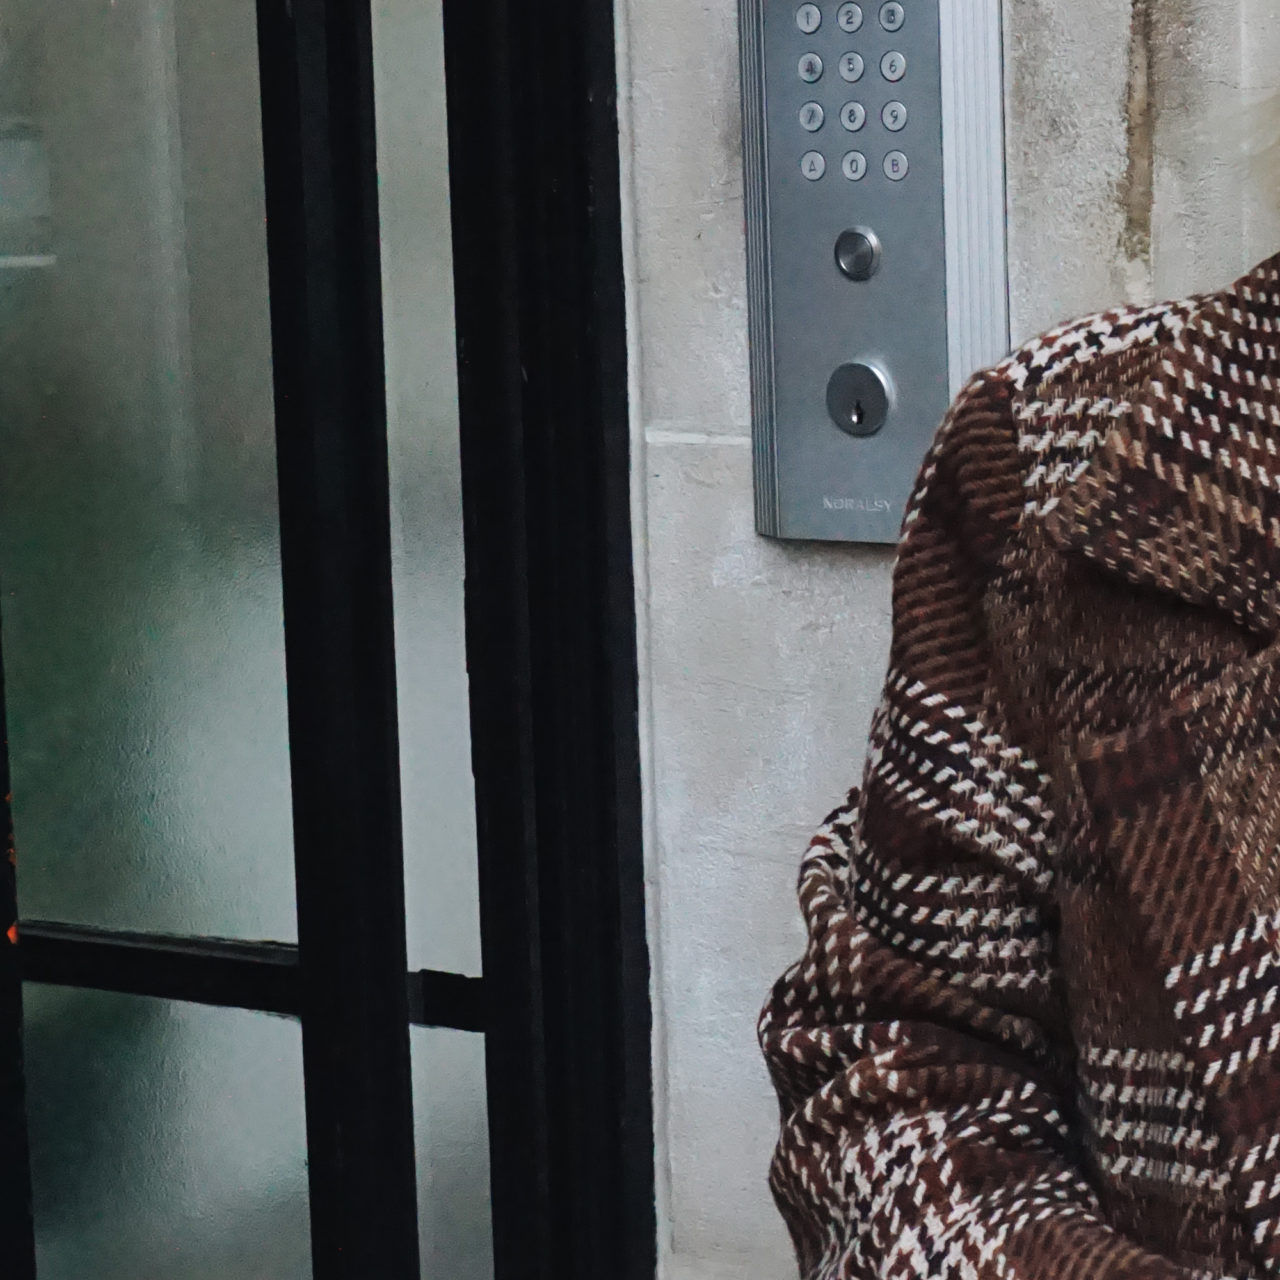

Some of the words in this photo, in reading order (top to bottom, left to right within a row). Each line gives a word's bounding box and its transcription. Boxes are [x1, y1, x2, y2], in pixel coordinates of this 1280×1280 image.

[845, 9, 854, 25] 2
[805, 60, 816, 75] 4
[847, 57, 855, 72] 5
[889, 59, 897, 74] 6
[807, 109, 816, 124] 7
[848, 108, 857, 123] 8
[890, 109, 898, 125] 9
[809, 160, 817, 173] A
[891, 158, 900, 174] B
